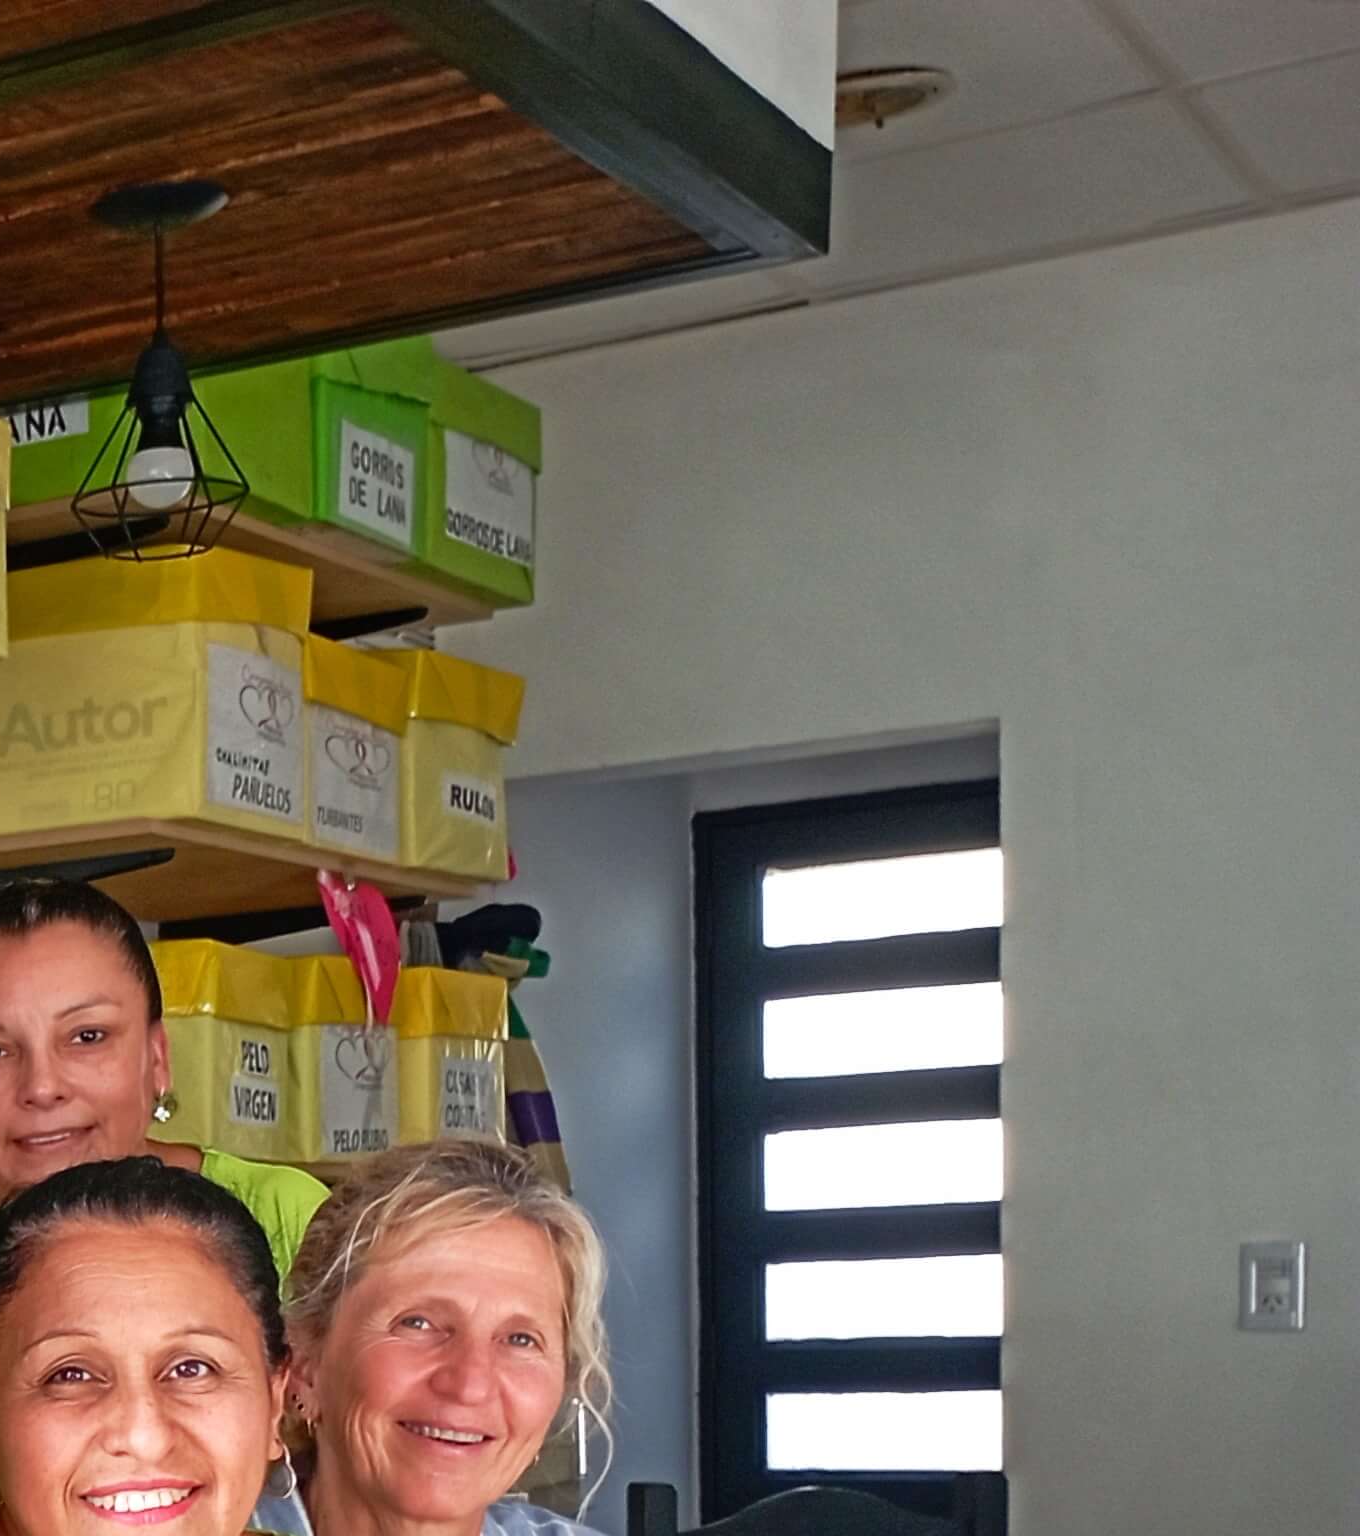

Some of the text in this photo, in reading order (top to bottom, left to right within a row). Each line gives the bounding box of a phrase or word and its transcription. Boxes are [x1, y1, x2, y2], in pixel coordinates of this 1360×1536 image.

[349, 476, 367, 508] DE
[232, 773, 291, 815] PAÑUELOS
[450, 784, 496, 822] RULOS
[241, 1040, 269, 1076] PELO
[333, 1129, 359, 1152] PELO
